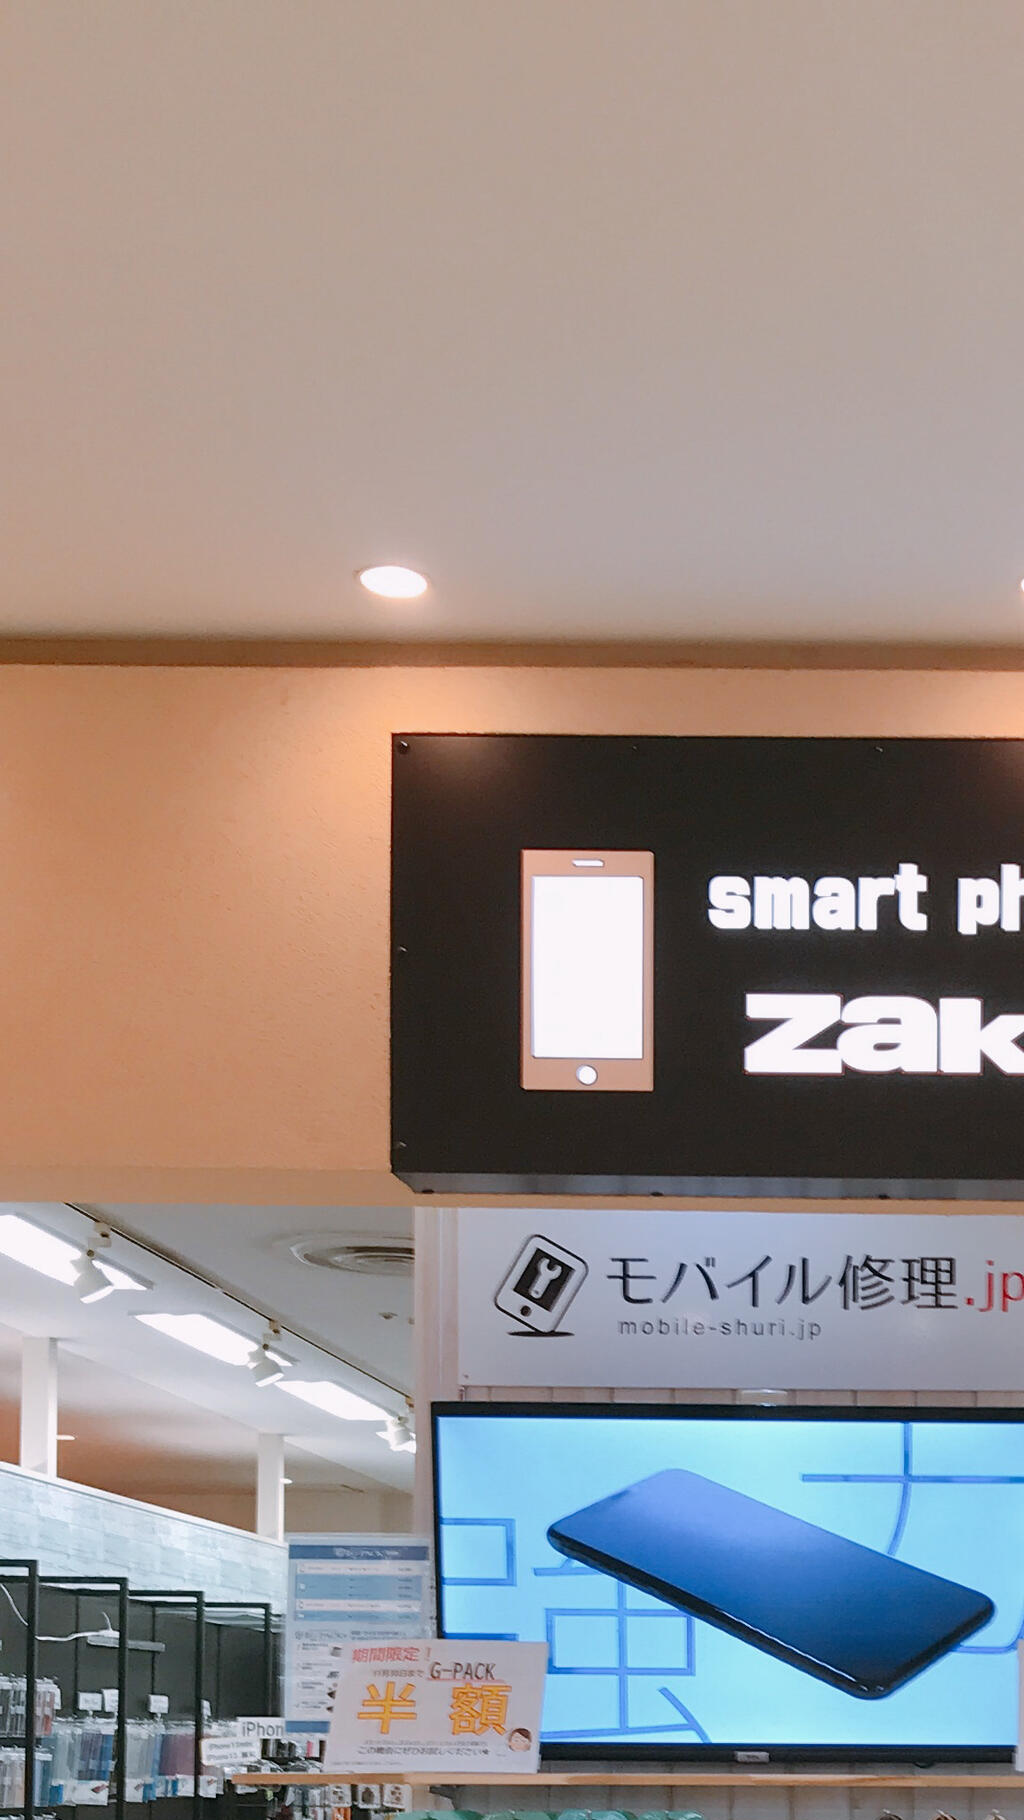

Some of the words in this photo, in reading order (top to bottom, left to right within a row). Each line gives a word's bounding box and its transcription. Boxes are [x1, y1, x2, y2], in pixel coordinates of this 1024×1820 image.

[707, 864, 930, 934] smart
[618, 1315, 823, 1341] mobile-shuri.jp
[430, 1661, 497, 1680] G-PACK
[242, 1721, 284, 1737] iPhon
